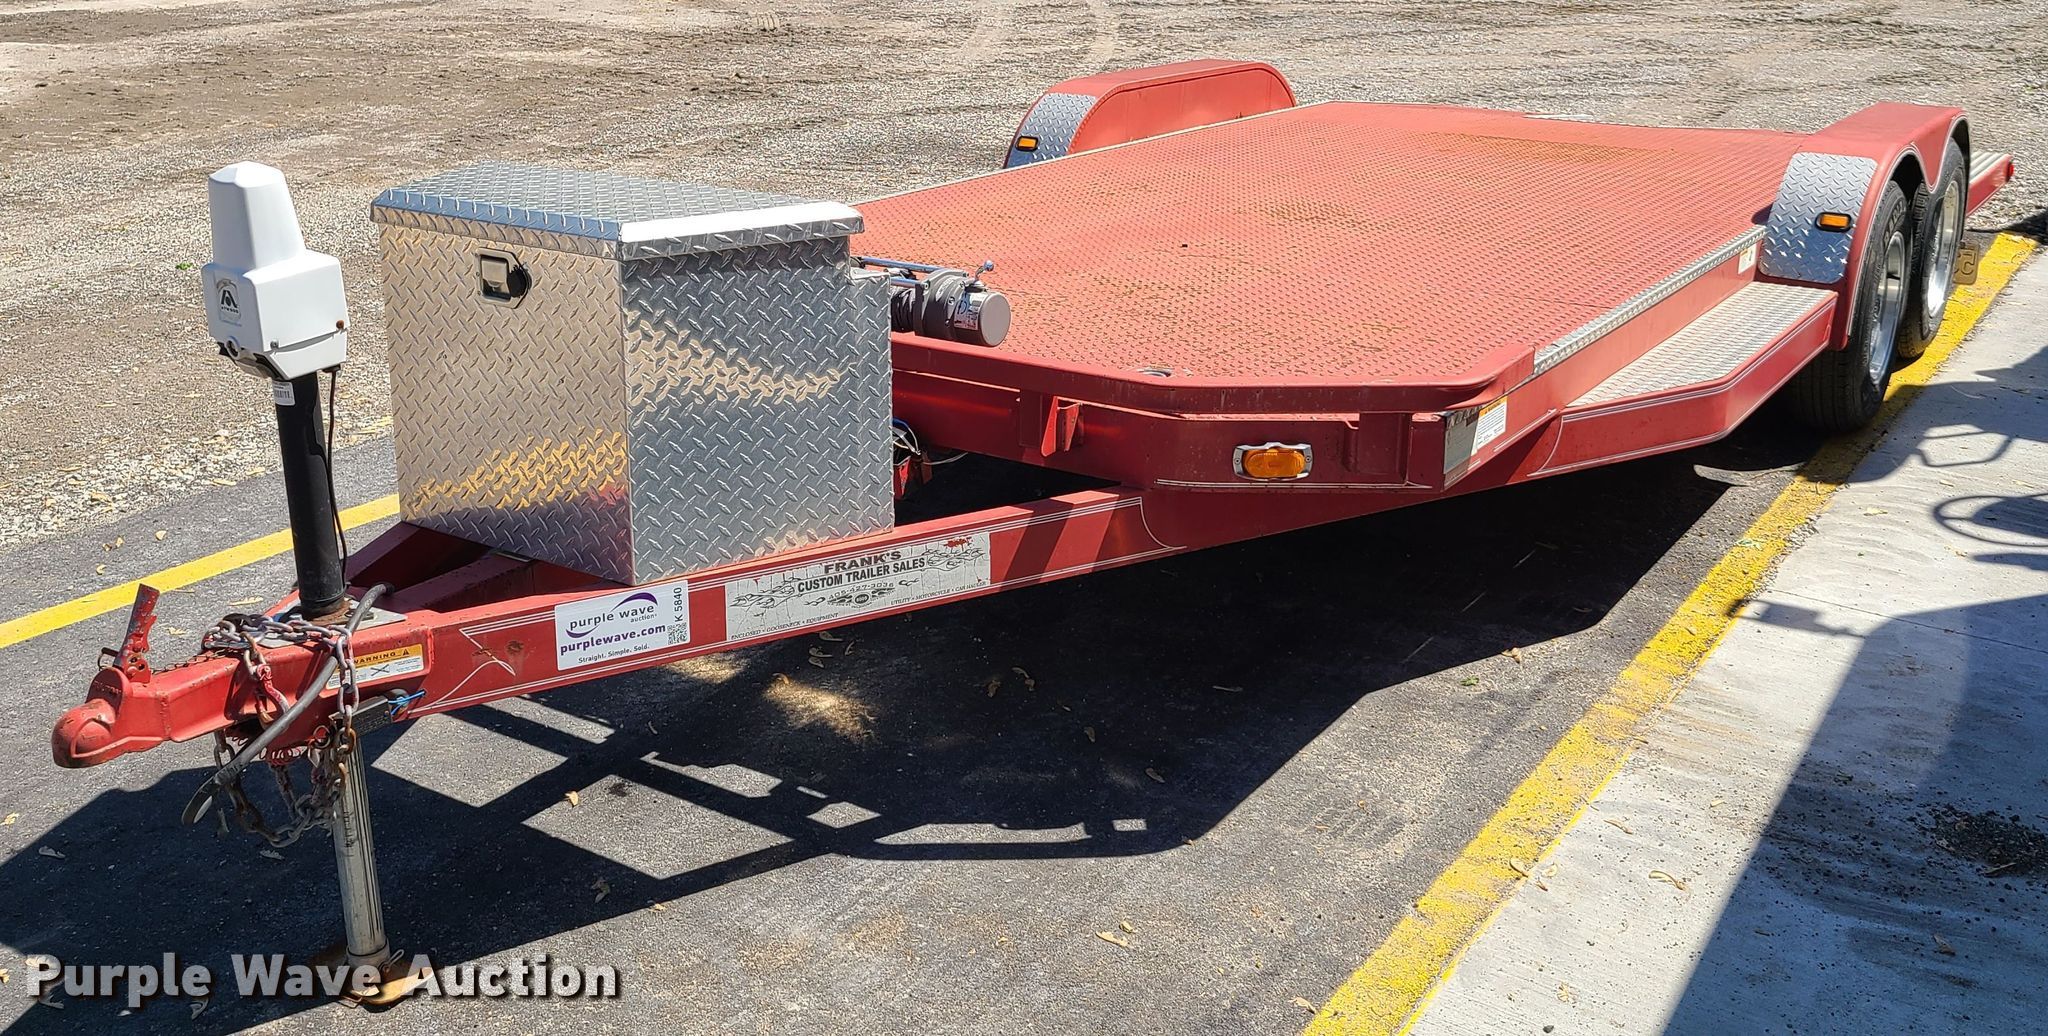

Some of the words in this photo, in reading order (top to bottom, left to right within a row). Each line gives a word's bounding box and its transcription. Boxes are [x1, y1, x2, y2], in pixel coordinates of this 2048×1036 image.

[797, 574, 843, 593] CUSTOM
[846, 565, 890, 582] TRAILER
[893, 557, 926, 573] SALES
[823, 551, 901, 574] FRANK'S
[673, 587, 683, 612] 5840
[890, 597, 910, 606] UTILITY
[915, 588, 951, 600] MOTORCYCLE
[570, 612, 614, 631] purple
[619, 604, 655, 619] wave
[674, 614, 683, 622] K
[731, 629, 762, 640] ENCLOSED
[766, 620, 801, 632] GOOSENECK
[806, 612, 839, 624] EQUIPMENT
[560, 624, 666, 656] purplewave.com
[578, 653, 607, 664] Straight.
[608, 648, 632, 658] Simple.
[633, 643, 650, 652] Sold.
